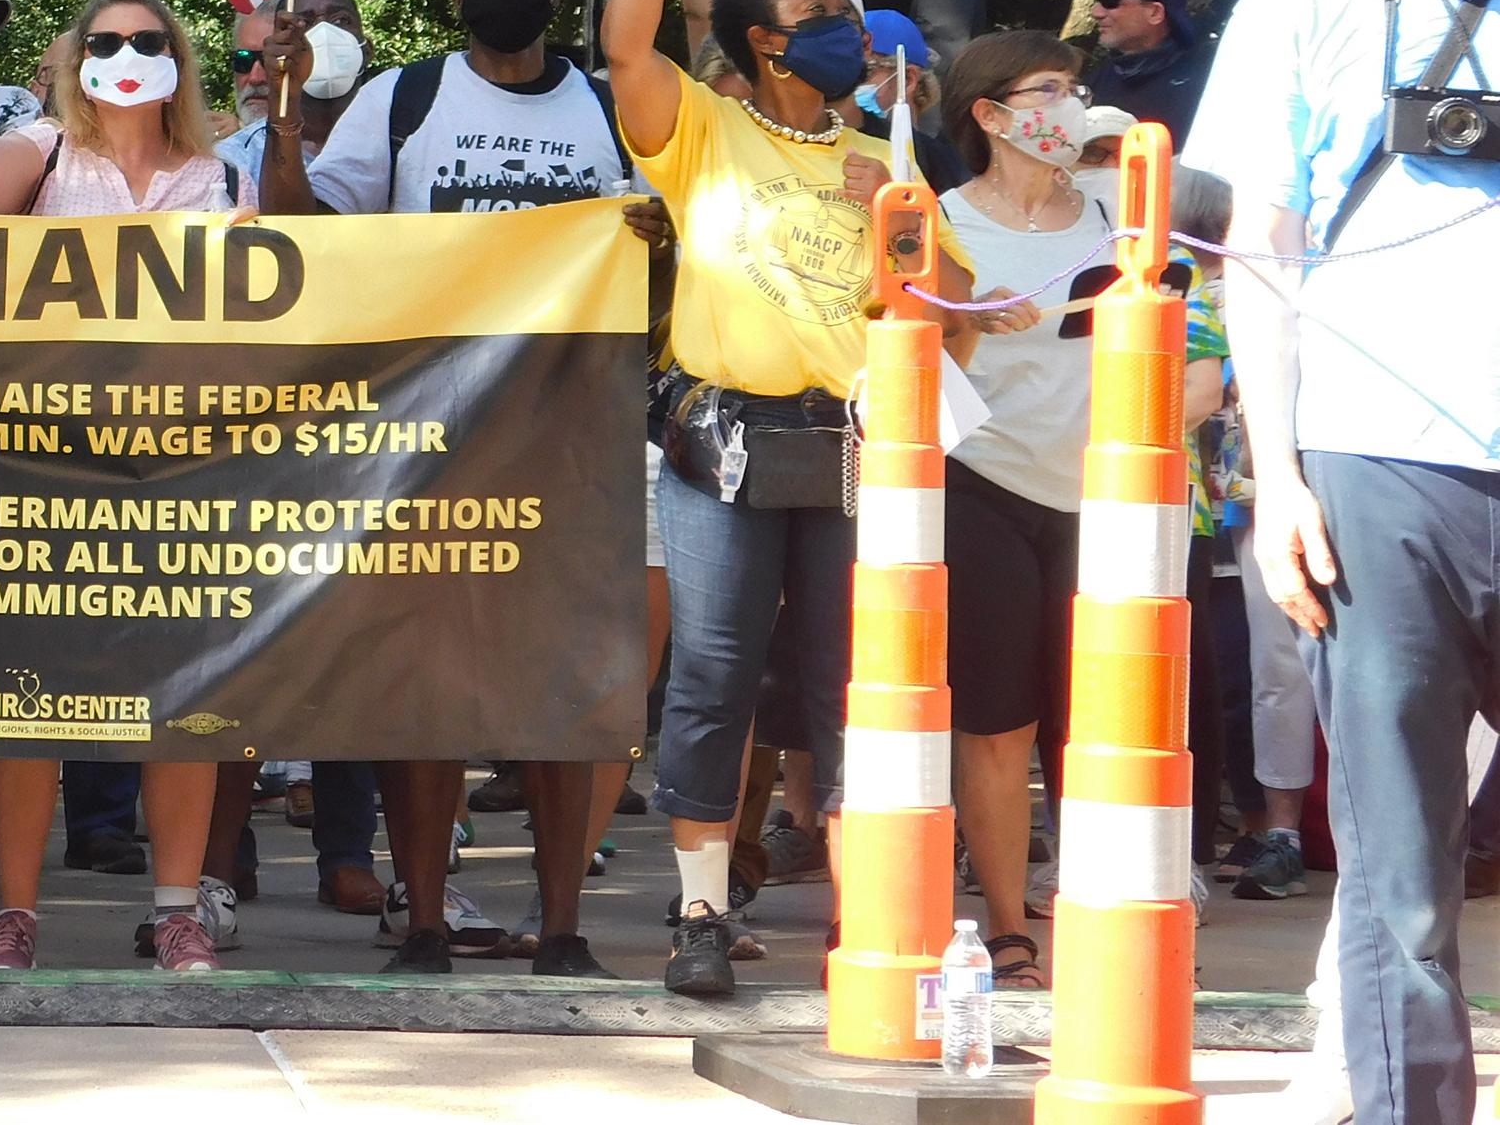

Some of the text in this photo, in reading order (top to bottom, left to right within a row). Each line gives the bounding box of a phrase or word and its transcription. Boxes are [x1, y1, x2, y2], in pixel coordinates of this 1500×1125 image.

[456, 135, 576, 157] WE ARE THE
[768, 181, 789, 195] FOR
[791, 225, 842, 256] NAACP
[105, 385, 185, 416] THE
[199, 380, 379, 416] FEDERAL
[86, 426, 213, 456] WAGE
[226, 424, 282, 455] TO
[295, 422, 448, 456] $15/HR
[250, 497, 542, 533] PROTECTIONS
[64, 541, 144, 574] ALL
[158, 541, 520, 576] UNDOCUMENTED
[57, 694, 150, 721] CENTER
[34, 726, 67, 735] RIGHTS
[77, 727, 109, 736] SOCIAL
[111, 728, 147, 737] JUSTICE
